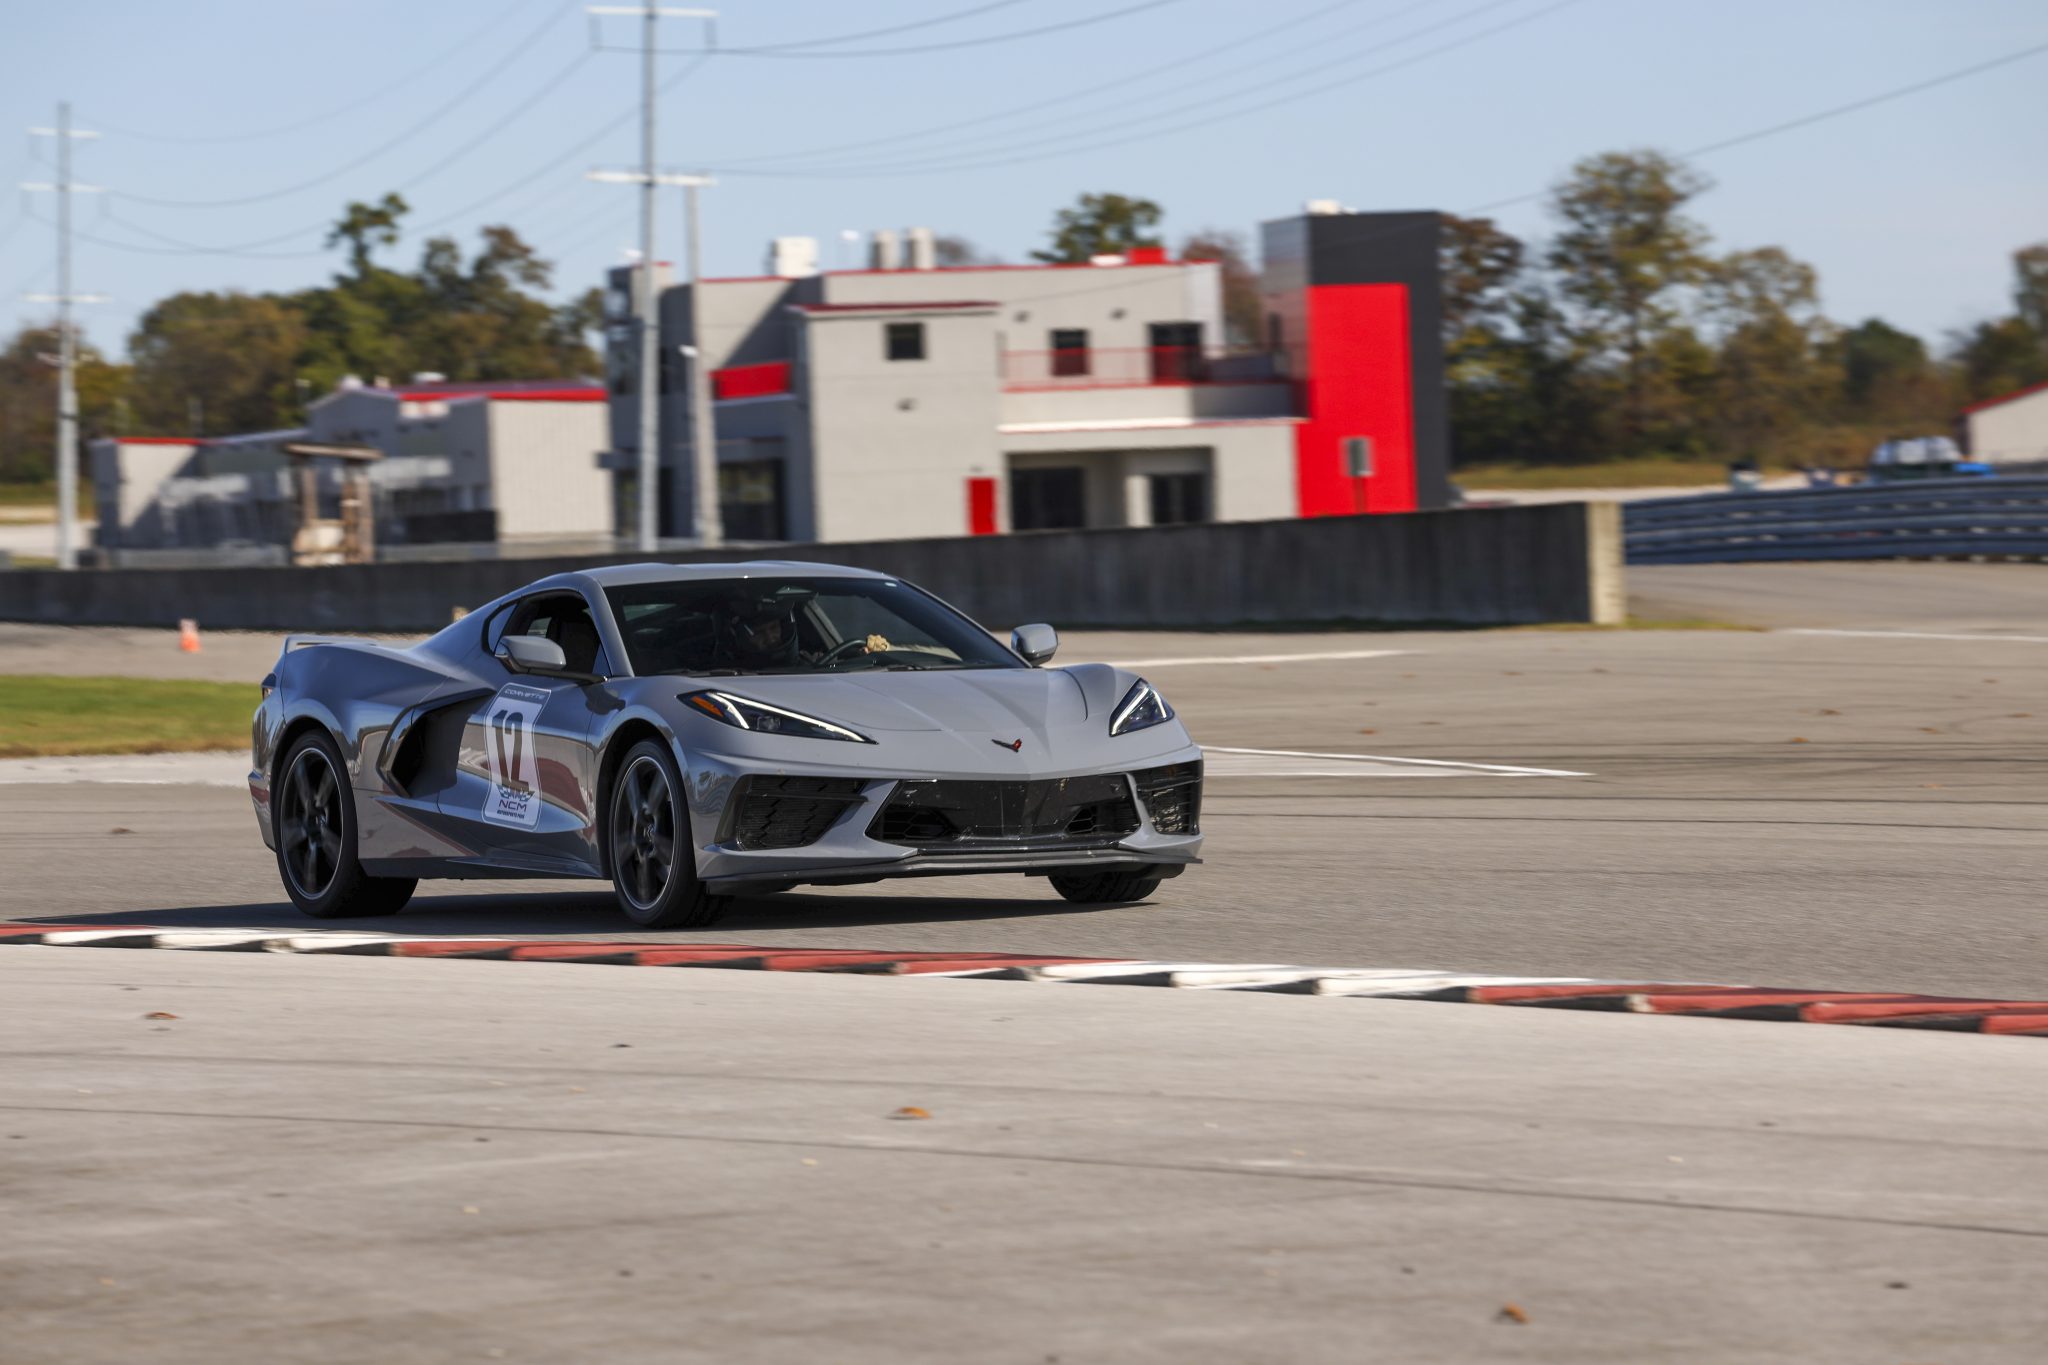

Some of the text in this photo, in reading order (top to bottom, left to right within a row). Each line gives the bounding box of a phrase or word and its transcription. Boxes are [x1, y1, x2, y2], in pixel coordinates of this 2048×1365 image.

[504, 689, 546, 700] CORVETTE
[491, 709, 530, 792] 12
[498, 799, 528, 812] NCM
